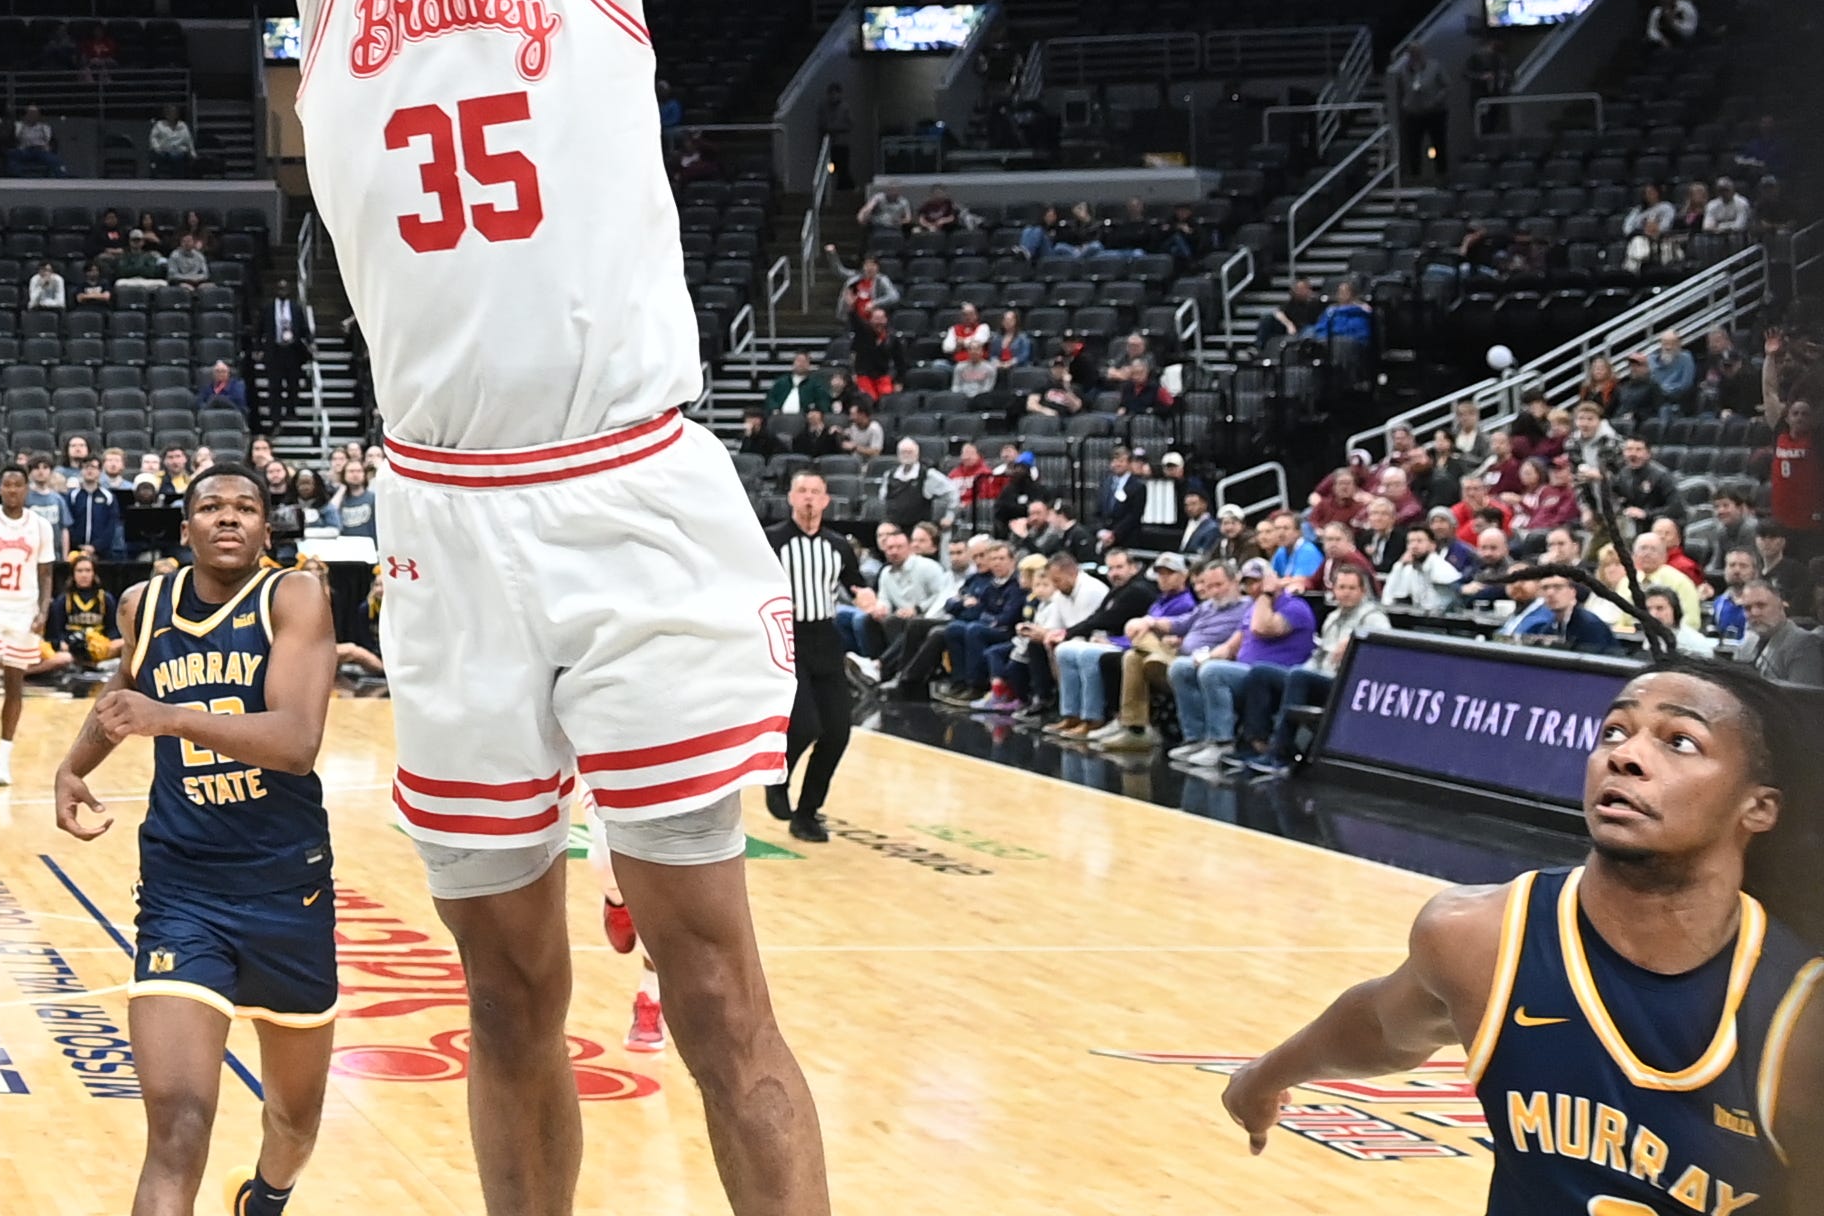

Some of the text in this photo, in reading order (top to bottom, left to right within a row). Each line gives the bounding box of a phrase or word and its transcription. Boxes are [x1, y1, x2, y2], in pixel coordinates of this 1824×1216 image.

[383, 91, 544, 253] 35
[151, 651, 263, 698] MURRAY
[1350, 678, 1446, 726] EVENTS
[1449, 693, 1521, 736] THAT
[182, 767, 268, 807] STATE
[1506, 1089, 1761, 1216] MURRAY
